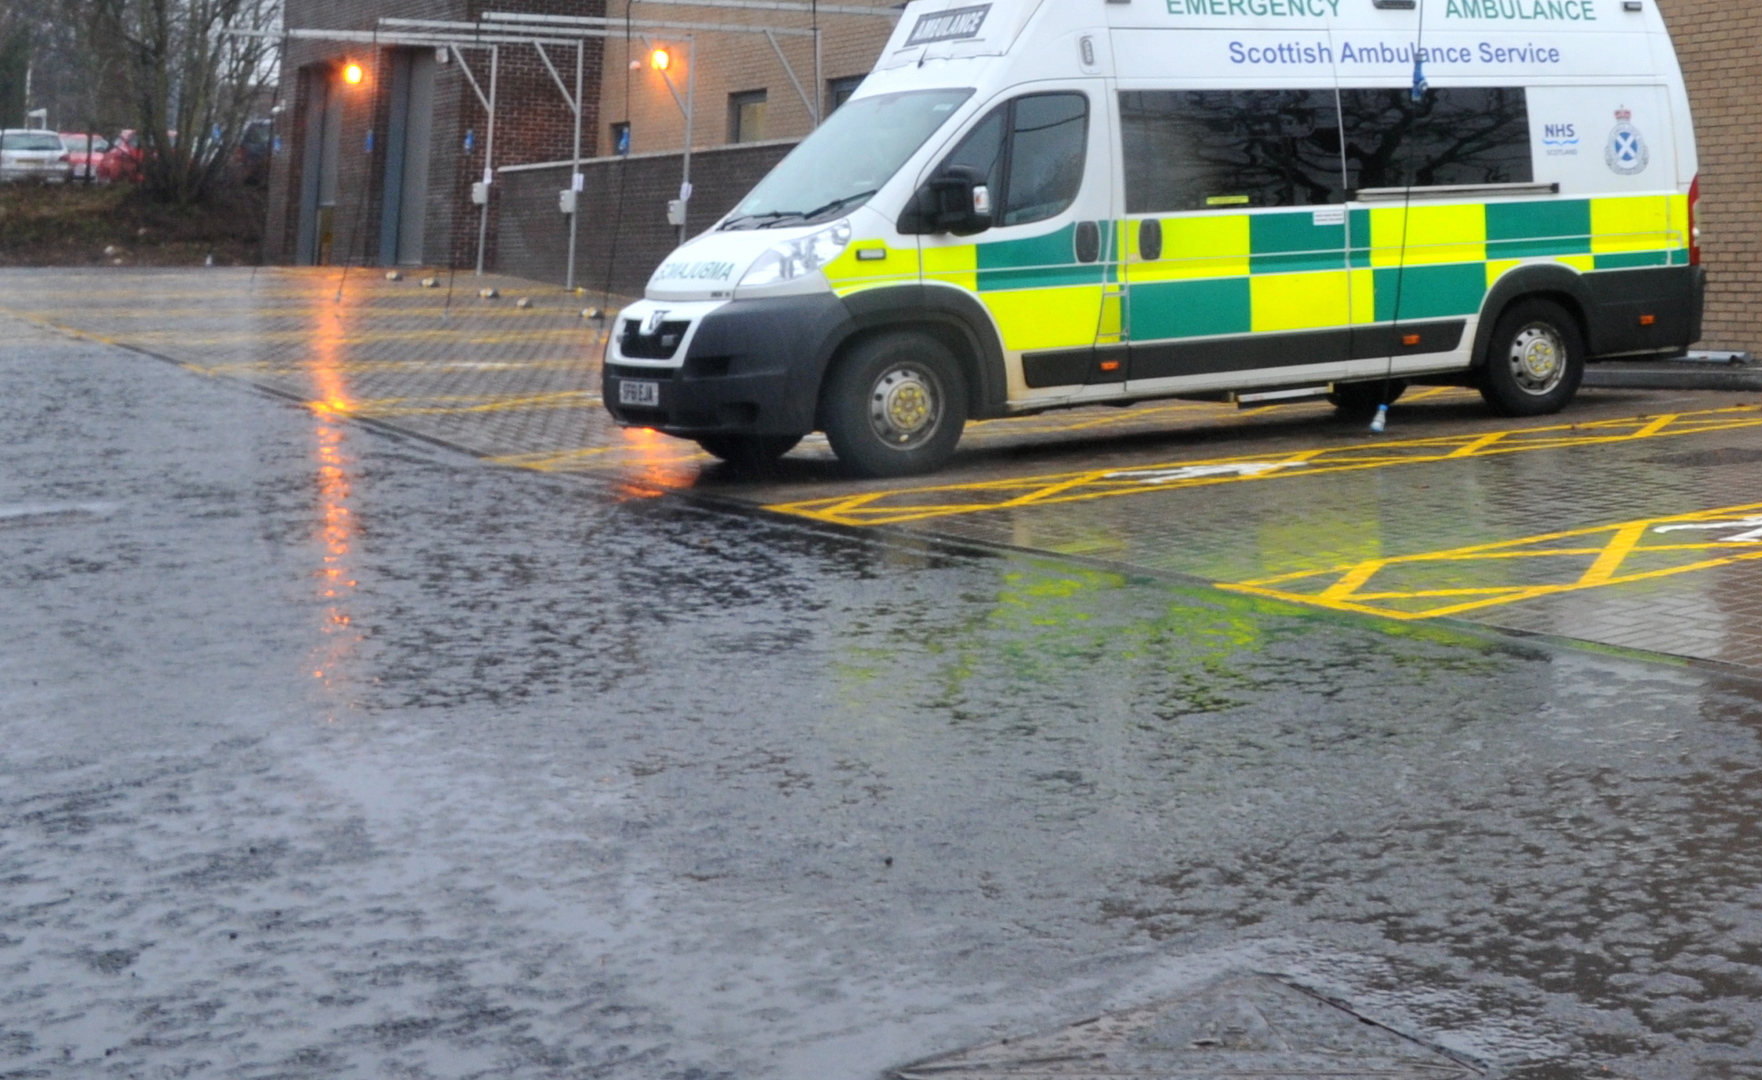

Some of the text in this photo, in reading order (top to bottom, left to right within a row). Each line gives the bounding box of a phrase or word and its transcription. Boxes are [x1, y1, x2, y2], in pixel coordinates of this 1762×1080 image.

[911, 10, 985, 41] AMBULANCE
[1229, 41, 1560, 64] Scottish Ambulance Service
[1545, 123, 1575, 138] NHS
[1547, 148, 1578, 156] SCOTLAND
